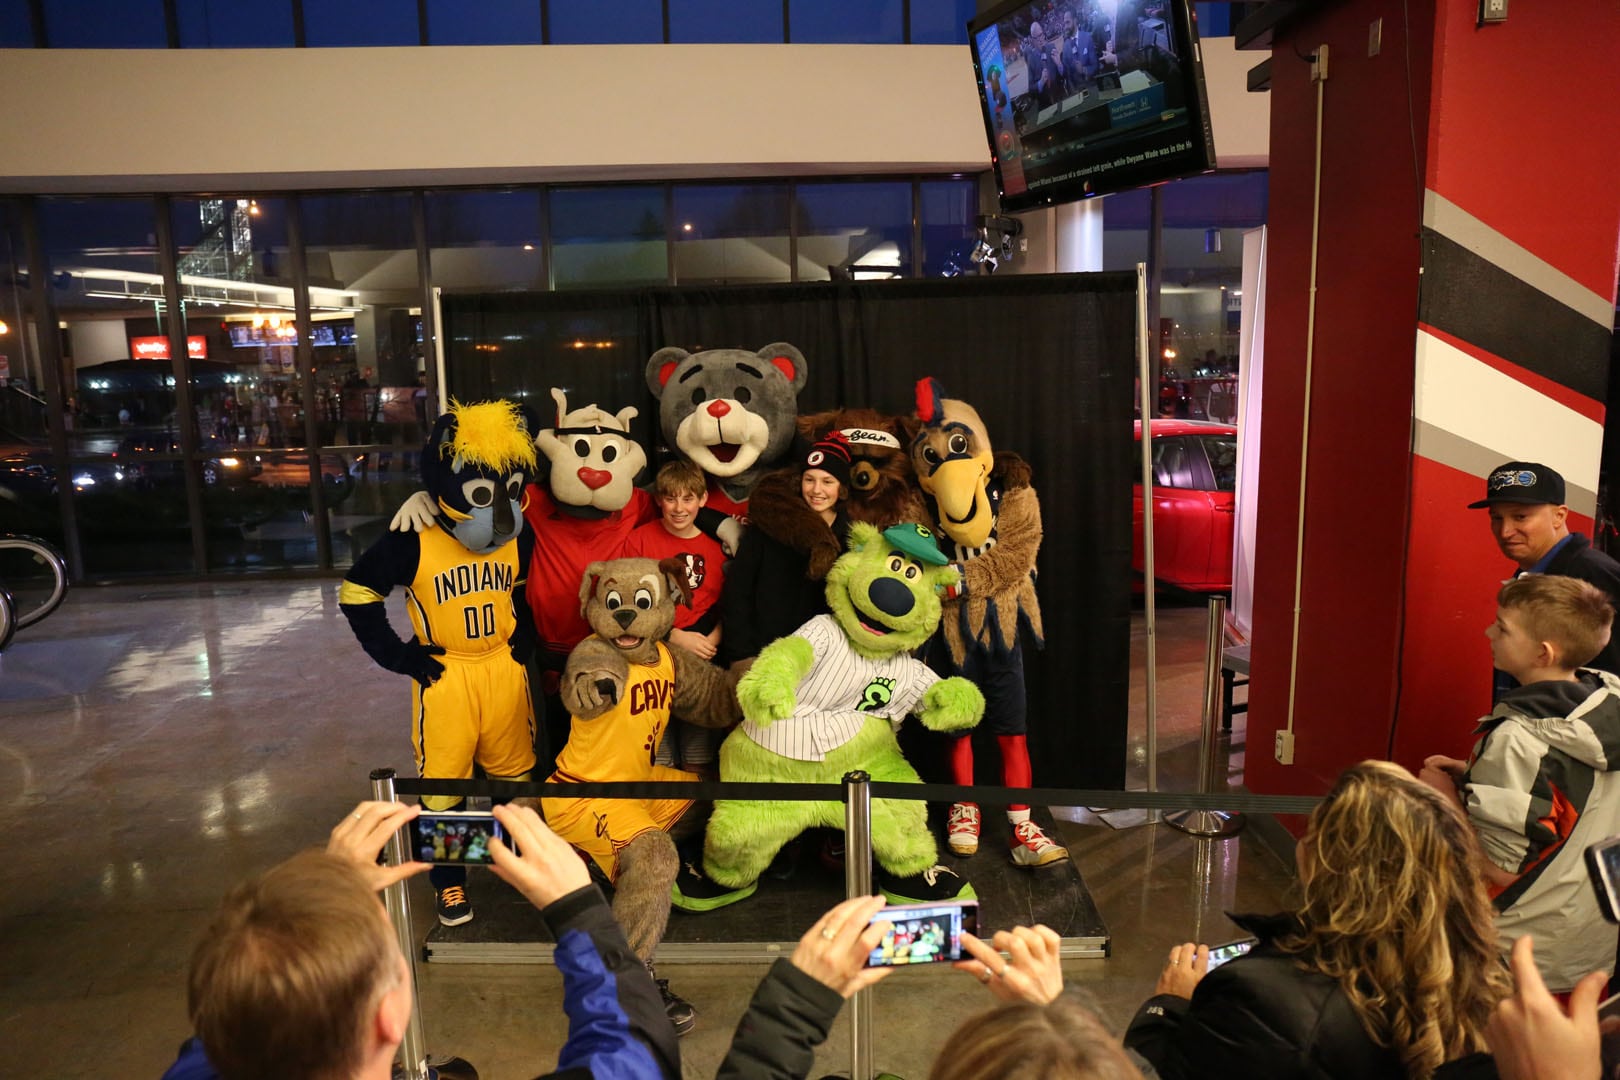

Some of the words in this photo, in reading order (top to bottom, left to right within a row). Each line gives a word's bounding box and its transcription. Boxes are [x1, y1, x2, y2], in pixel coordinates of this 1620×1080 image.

[1144, 149, 1159, 159] Wade
[1159, 147, 1170, 156] was
[1176, 143, 1185, 152] the
[434, 561, 513, 605] INDIANA
[463, 602, 496, 640] 00
